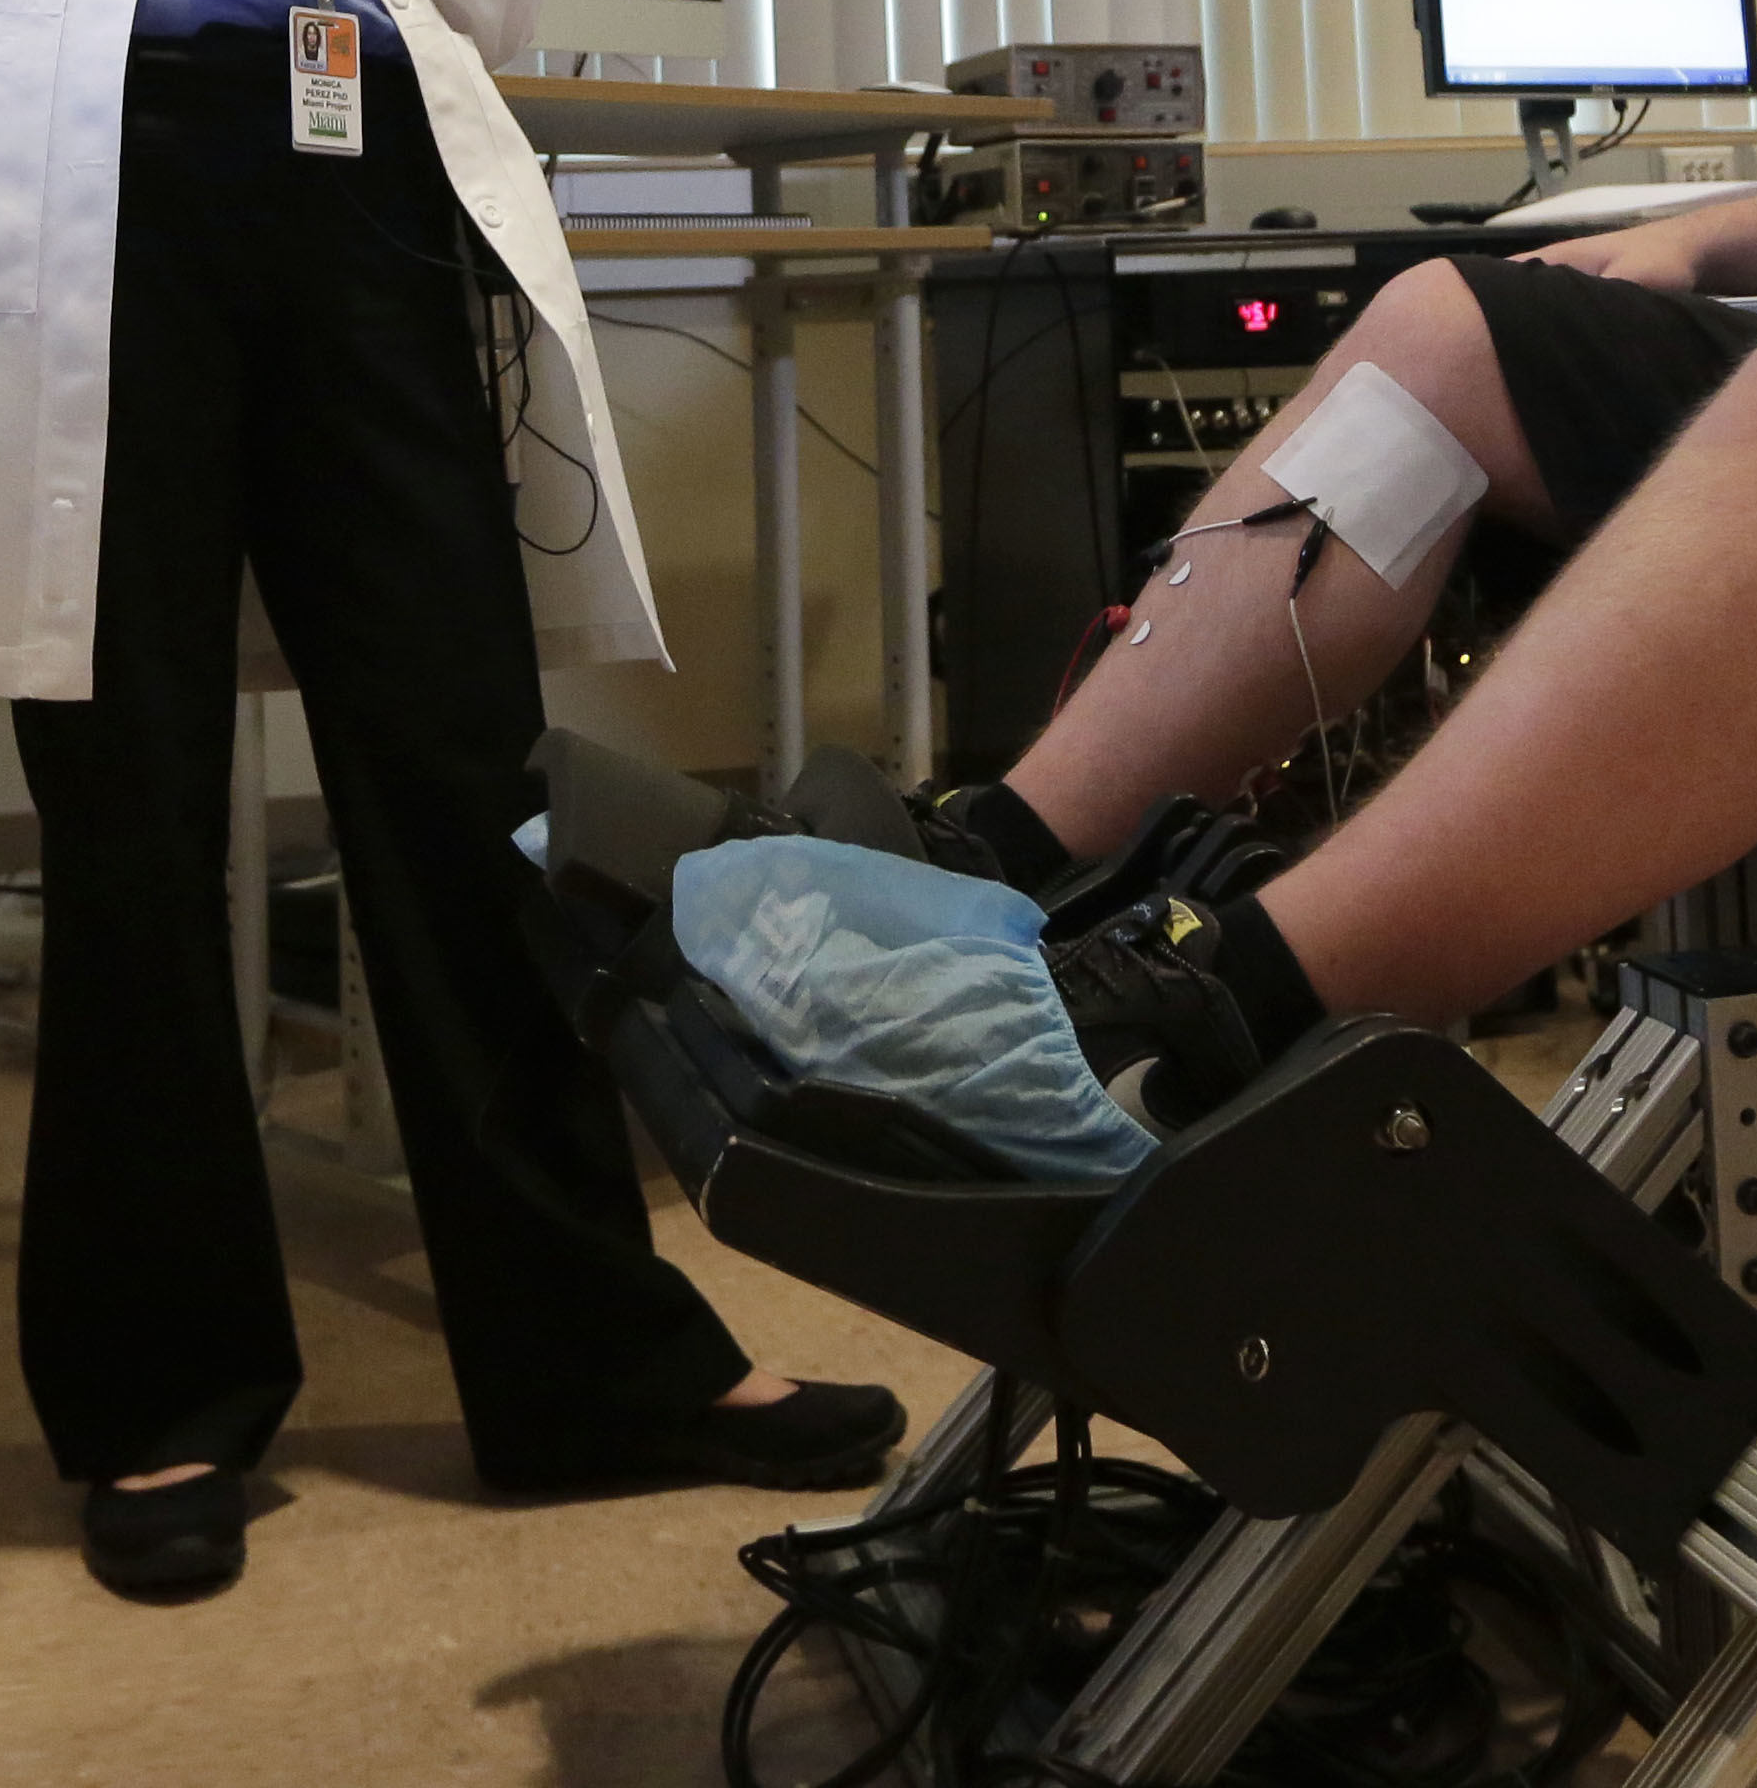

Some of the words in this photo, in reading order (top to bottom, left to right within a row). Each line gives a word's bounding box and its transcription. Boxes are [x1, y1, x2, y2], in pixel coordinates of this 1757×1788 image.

[311, 78, 342, 89] MONICA
[305, 88, 331, 99] PEREZ
[309, 111, 346, 131] Miami
